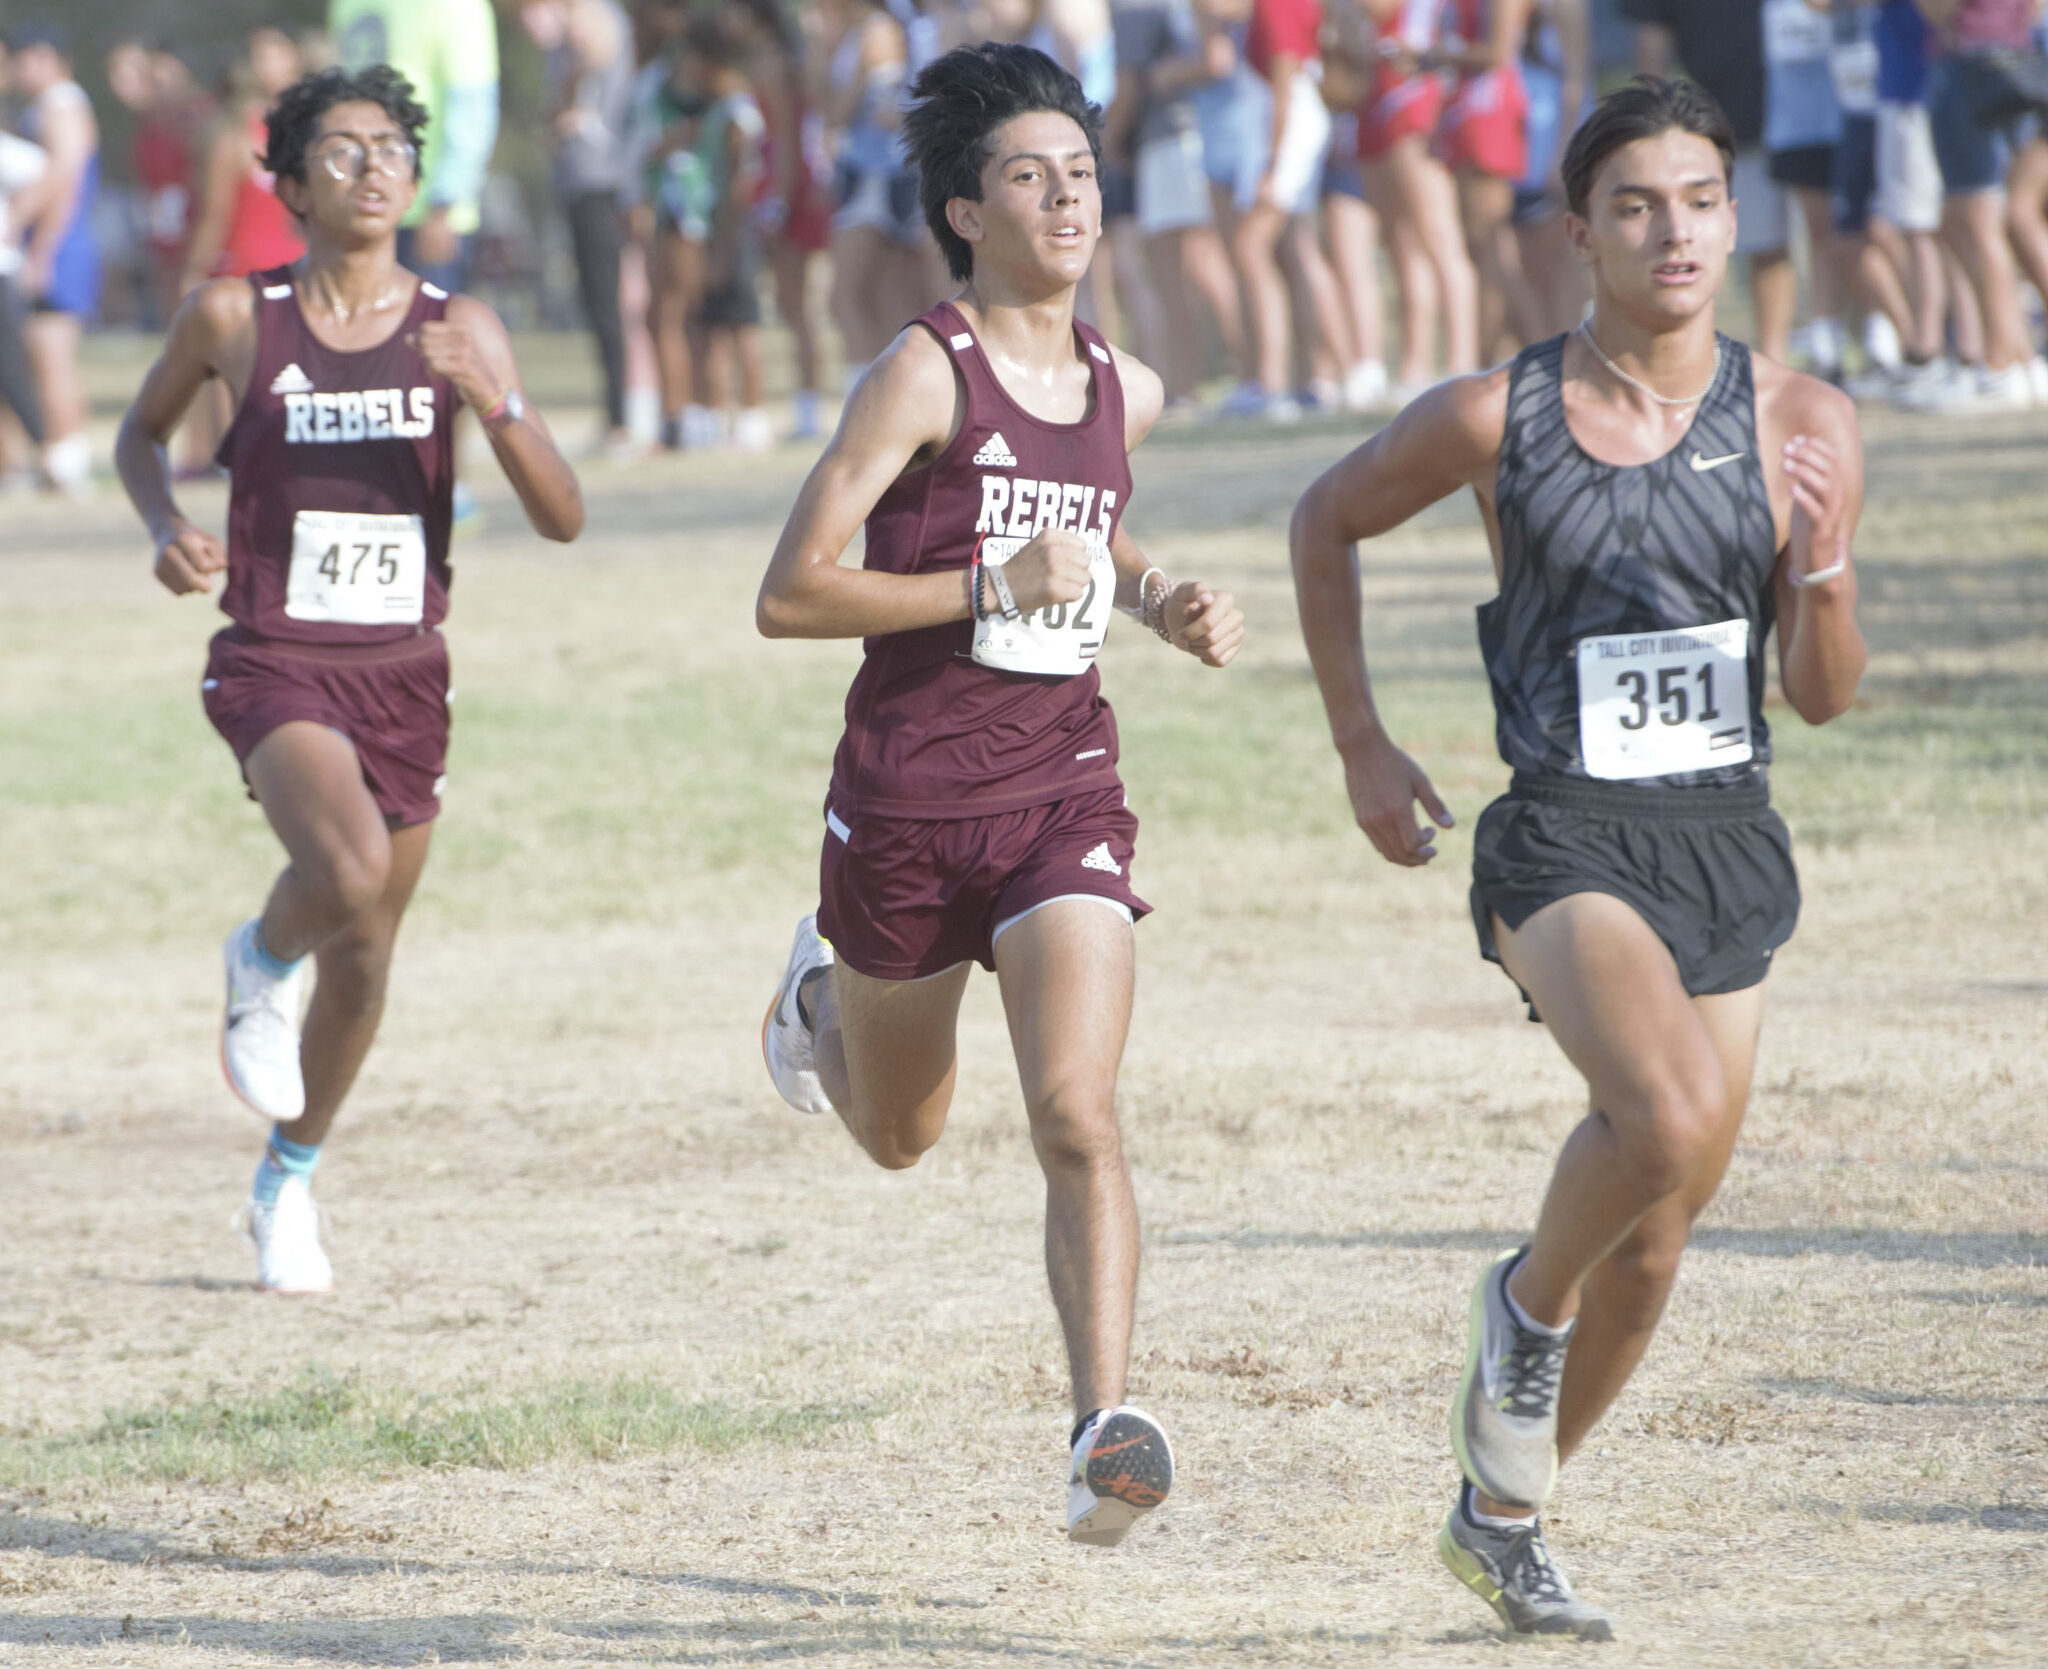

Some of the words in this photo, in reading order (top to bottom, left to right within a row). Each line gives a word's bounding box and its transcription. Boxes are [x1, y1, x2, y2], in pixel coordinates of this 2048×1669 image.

[284, 387, 435, 443] REBELS
[975, 475, 1117, 545] REBELS
[318, 543, 402, 585] 475
[1597, 640, 1625, 658] TALL
[1630, 638, 1656, 656] CITY
[1616, 662, 1720, 730] 351
